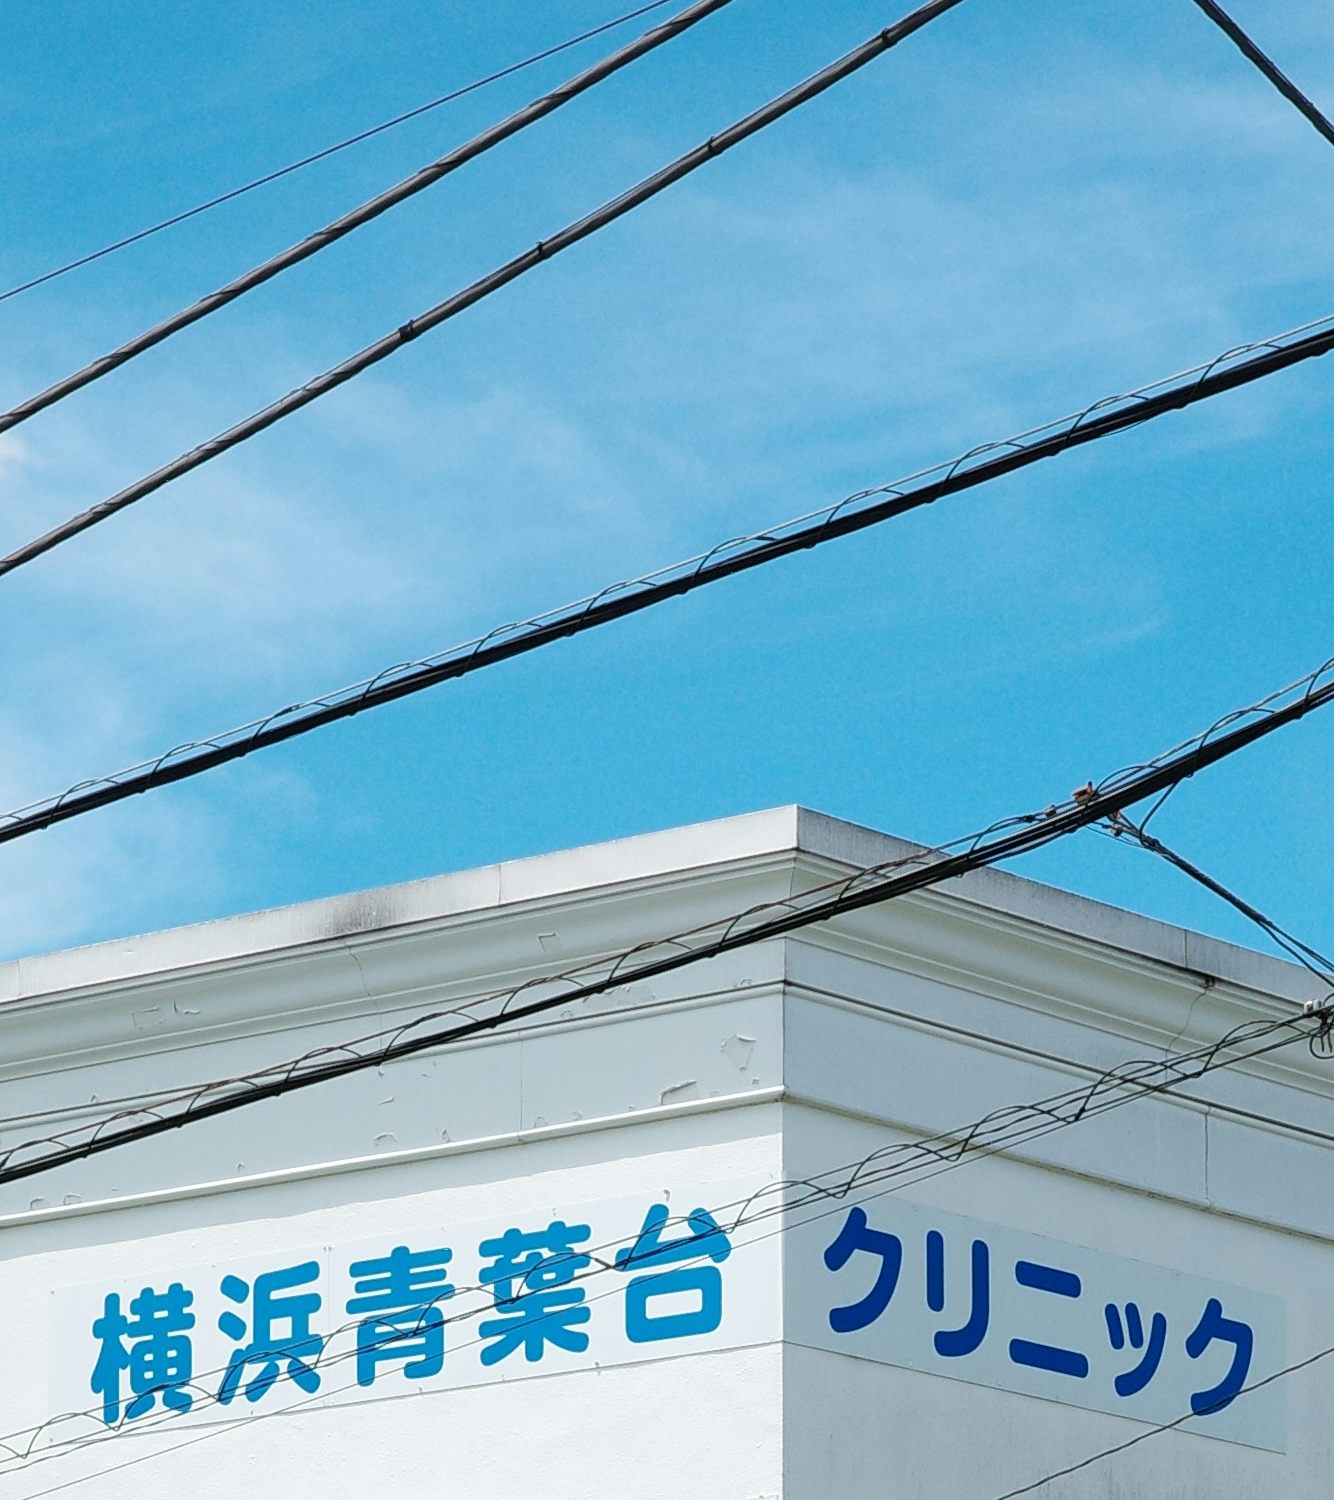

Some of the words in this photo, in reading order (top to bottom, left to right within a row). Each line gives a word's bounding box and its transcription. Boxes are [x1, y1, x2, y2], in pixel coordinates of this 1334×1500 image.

[91, 1203, 733, 1423] 横浜青葉台
[824, 1206, 1255, 1414] クリニック
